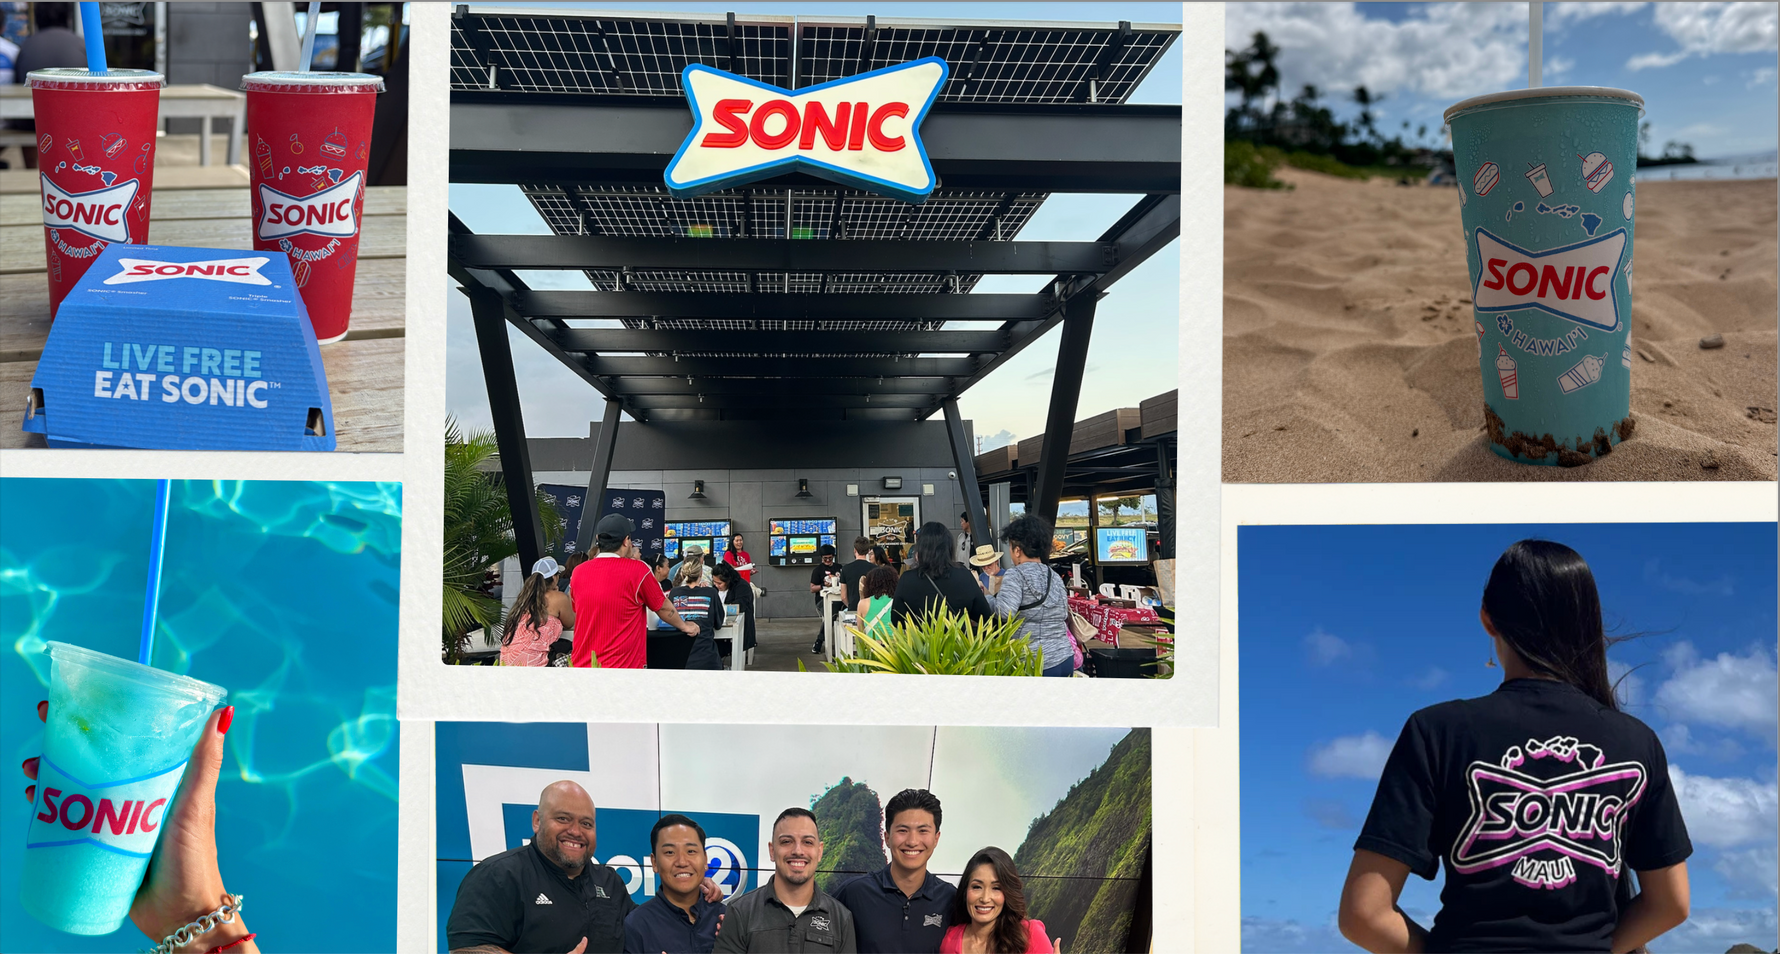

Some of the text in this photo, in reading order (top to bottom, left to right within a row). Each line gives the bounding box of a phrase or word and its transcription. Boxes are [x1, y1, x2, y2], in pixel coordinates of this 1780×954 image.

[700, 99, 910, 152] SONIC
[45, 193, 122, 226] SONIC
[267, 198, 351, 227] SONIC
[125, 264, 251, 277] SONIC
[1483, 257, 1610, 301] SONIC
[102, 342, 262, 378] LIVE FREE
[94, 370, 156, 401] EAT
[37, 787, 167, 836] SONIC
[1474, 792, 1624, 839] SONIC
[1511, 856, 1577, 886] MAUI
